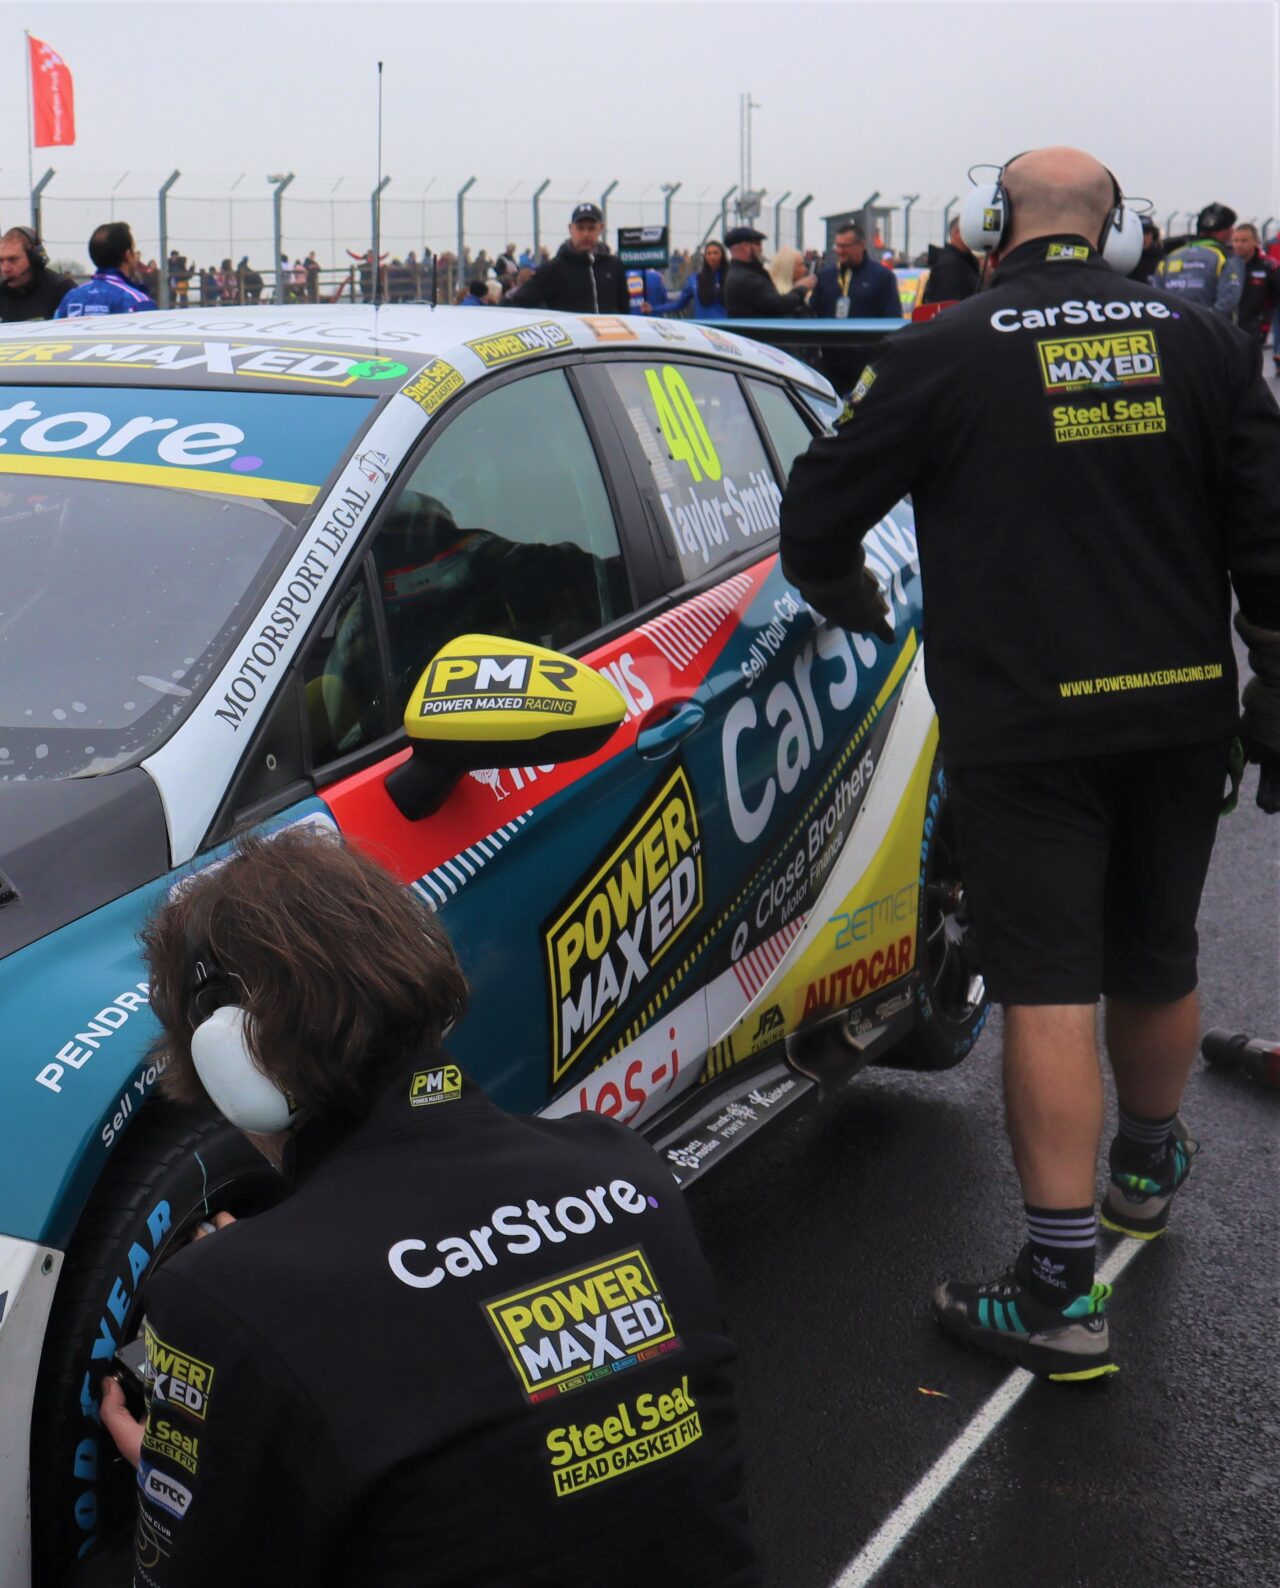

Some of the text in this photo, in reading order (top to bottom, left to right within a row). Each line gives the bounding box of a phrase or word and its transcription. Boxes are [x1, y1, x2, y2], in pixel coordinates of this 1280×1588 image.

[621, 251, 665, 261] OSBORNE
[68, 342, 351, 377] MAXED
[475, 335, 524, 360] POWER
[517, 325, 566, 350] MAXED
[1045, 336, 1150, 365] POWER
[402, 358, 453, 402] Steel Seal
[1049, 353, 1155, 384] MAXED
[645, 365, 722, 482] 40
[1053, 396, 1165, 427] Steel Seal
[1057, 420, 1164, 440] HEAD GASKET FIX
[660, 469, 784, 563] Taylor-Smith
[214, 486, 371, 732] MOTORSPORT LEGAL
[741, 591, 800, 689] Sell Your Car
[430, 658, 578, 693] PMR
[1059, 663, 1223, 698] WWW.POWERMAXEDRACING.COM
[423, 697, 573, 714] POWER MAXED RACING
[755, 749, 875, 929] Close Brothers
[559, 797, 689, 998] POWER
[781, 830, 844, 926] Motor Finance
[560, 859, 698, 1060] MAXED
[802, 935, 912, 1020] AUTOCAR
[751, 1029, 785, 1052] TUNING
[752, 1004, 786, 1040] JFA
[102, 1055, 171, 1148] Sell You
[412, 1068, 459, 1096] PMR
[500, 1262, 650, 1345] POWER
[518, 1298, 665, 1381] MAXED
[156, 1420, 199, 1459] Seal
[546, 1376, 696, 1467] Steel Seal
[555, 1416, 701, 1493] HEAD GASKET FIX
[150, 1475, 186, 1508] BTCC
